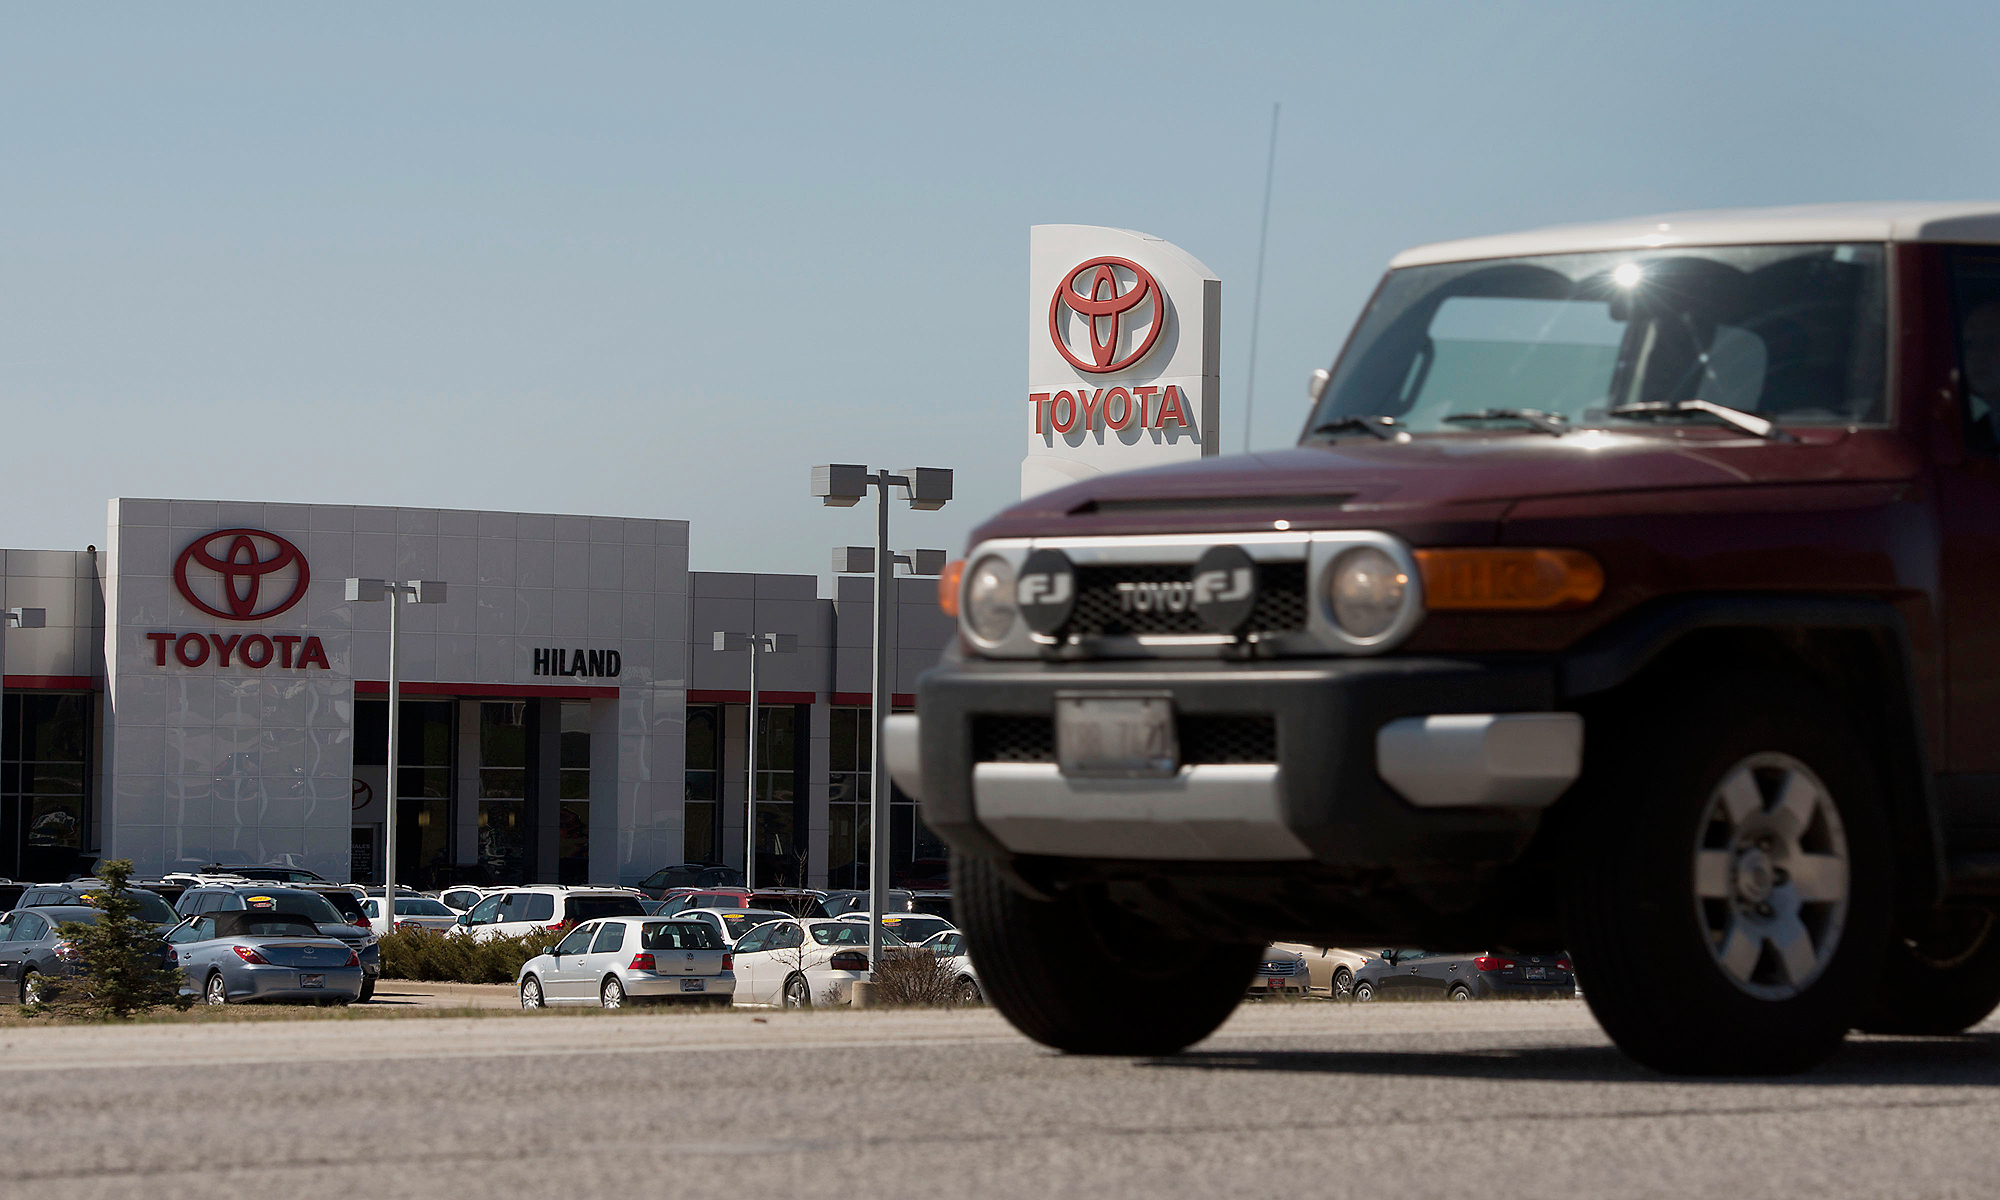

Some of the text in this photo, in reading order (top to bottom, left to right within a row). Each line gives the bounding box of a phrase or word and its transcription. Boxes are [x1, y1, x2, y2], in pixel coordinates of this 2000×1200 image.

[1029, 385, 1188, 435] TOYOTA
[1017, 572, 1072, 606] FJ
[1194, 567, 1252, 604] FJ
[146, 632, 331, 669] TOYOTA
[533, 648, 621, 677] HILAND
